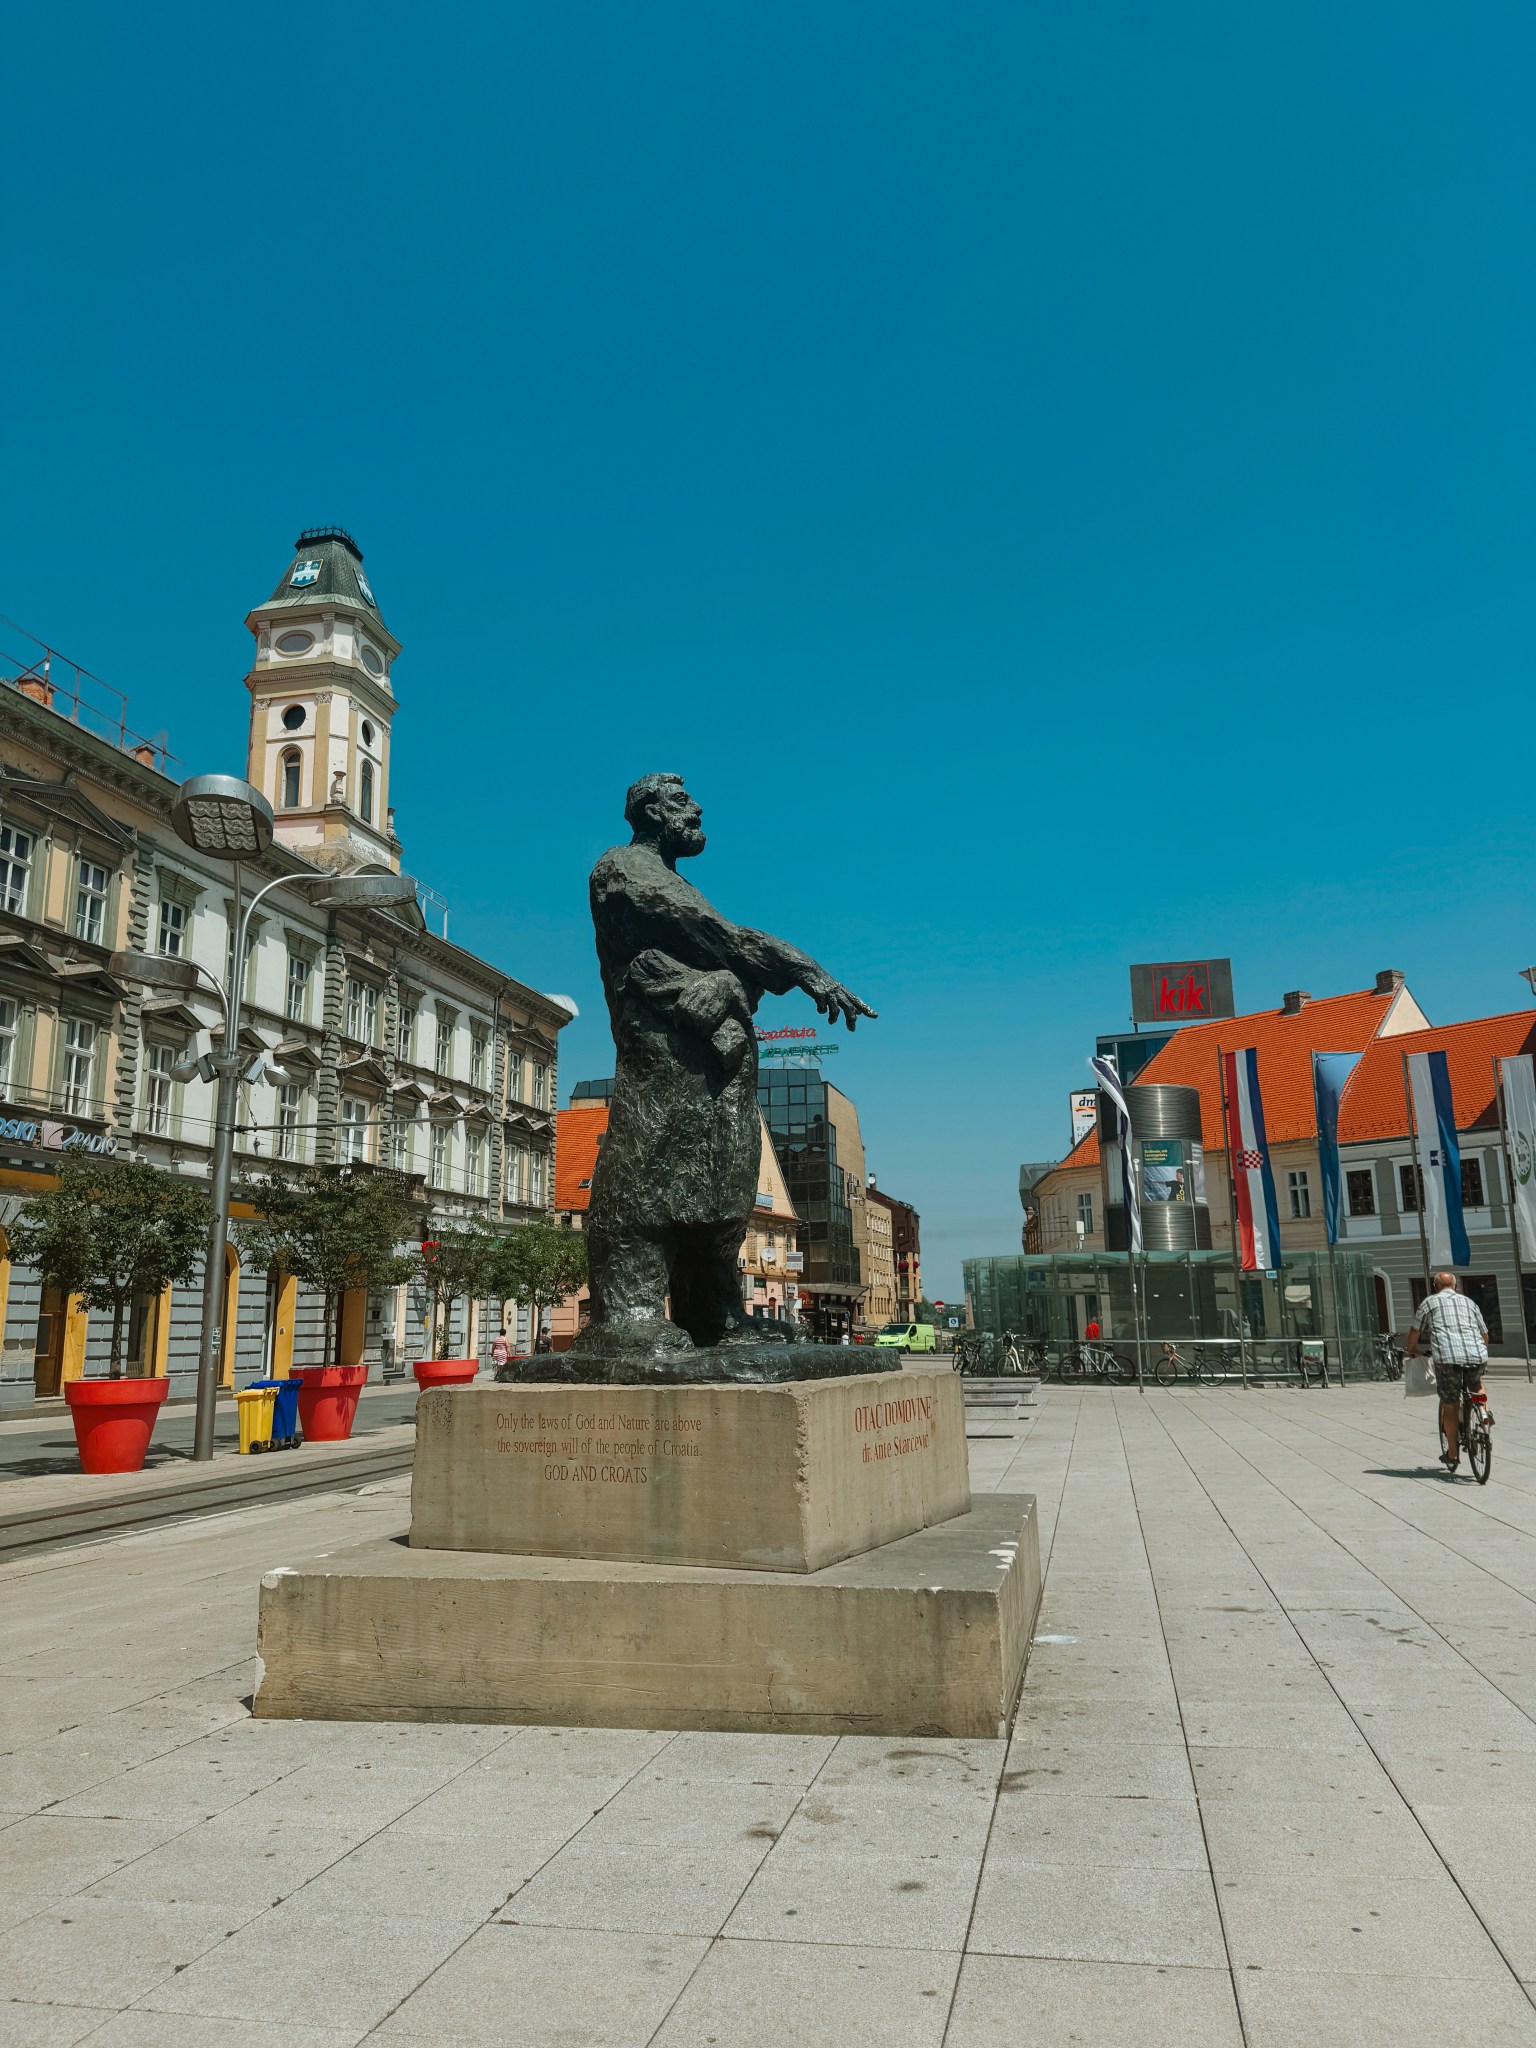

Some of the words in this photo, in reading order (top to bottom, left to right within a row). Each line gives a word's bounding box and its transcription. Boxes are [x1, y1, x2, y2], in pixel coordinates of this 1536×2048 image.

[1159, 969, 1205, 1013] kik
[496, 1413, 519, 1432] Only
[520, 1412, 535, 1430] the
[538, 1413, 559, 1430] laws
[561, 1414, 573, 1430] of
[576, 1413, 596, 1430] God
[598, 1414, 615, 1430] and
[618, 1415, 650, 1431] Nature
[654, 1419, 670, 1431] are
[672, 1416, 702, 1432] above
[855, 1404, 882, 1433] OTAC
[884, 1396, 933, 1427] DOMOVINE
[497, 1438, 511, 1453] the
[514, 1438, 557, 1457] sovereign
[561, 1438, 578, 1454] will
[581, 1438, 592, 1454] of
[596, 1438, 610, 1454] the
[613, 1439, 645, 1459] people
[647, 1440, 659, 1455] of
[663, 1440, 703, 1457] Croatia.
[874, 1442, 892, 1462] Ante
[544, 1465, 569, 1481] GOD
[572, 1465, 597, 1482] AND
[601, 1466, 648, 1484] CROATS
